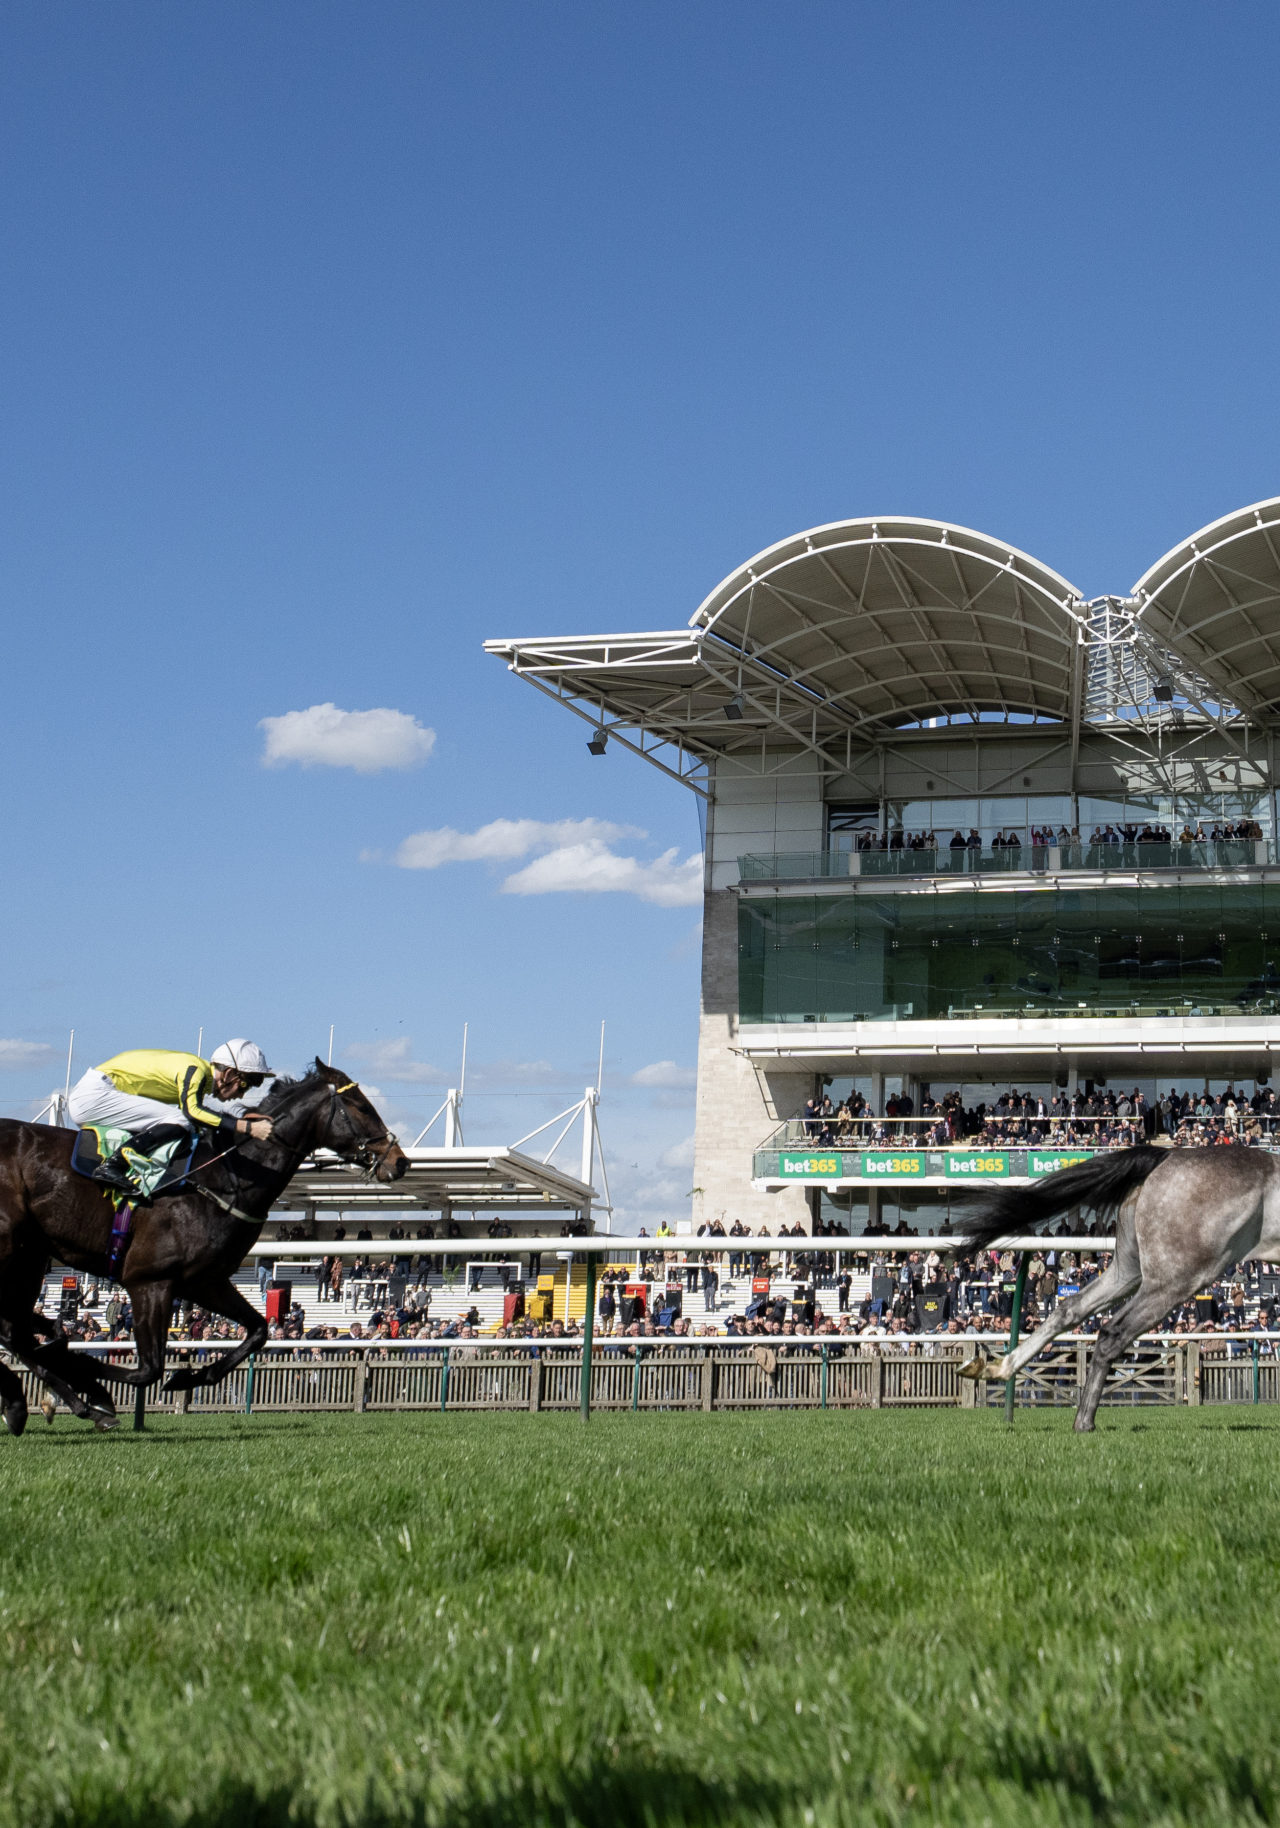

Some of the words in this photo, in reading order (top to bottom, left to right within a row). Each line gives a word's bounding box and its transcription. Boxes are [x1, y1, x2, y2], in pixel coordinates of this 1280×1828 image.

[784, 1158, 837, 1173] bet365
[866, 1158, 920, 1173] bet365
[949, 1158, 1004, 1172] bet365
